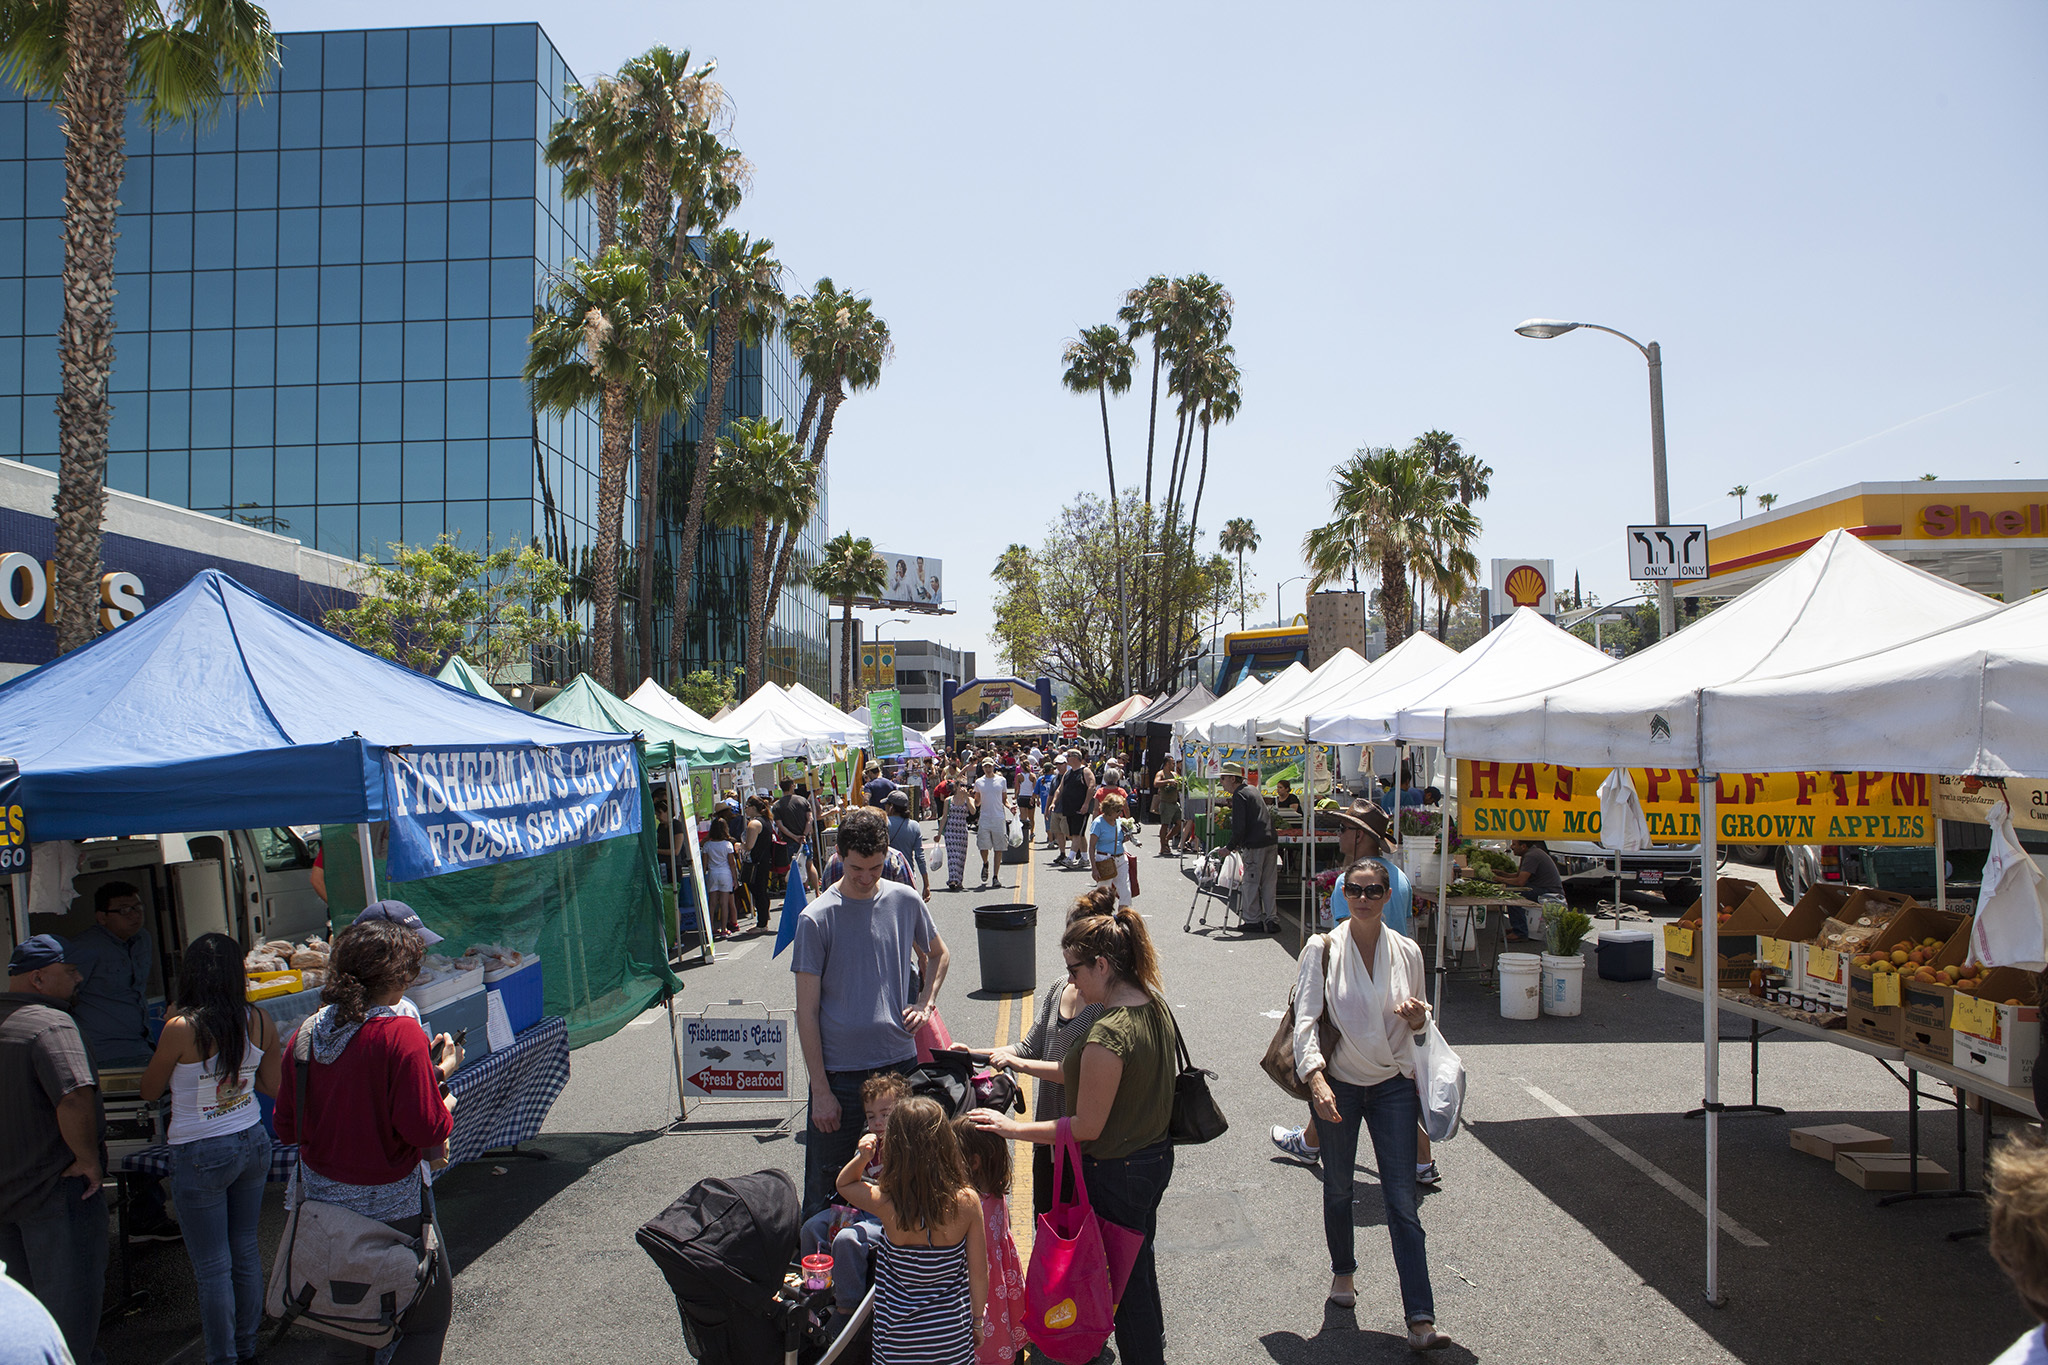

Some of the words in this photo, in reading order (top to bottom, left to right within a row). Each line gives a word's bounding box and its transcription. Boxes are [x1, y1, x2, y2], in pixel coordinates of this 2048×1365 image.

[1923, 504, 2048, 537] Shel
[1644, 566, 1668, 576] ONLY
[1681, 566, 1705, 575] ONLY
[570, 743, 637, 796] CATCH
[427, 814, 523, 867] FRESH
[526, 799, 622, 849] SEAFOOD
[1474, 808, 1550, 832] SNOW
[1562, 810, 1700, 836] MOTAIN
[1721, 813, 1816, 838] GROWN
[1828, 815, 1925, 838] APPLES
[688, 1023, 748, 1044] Fisherman's
[751, 1024, 782, 1046] Catch
[699, 1071, 733, 1088] Fresh
[736, 1072, 782, 1090] Seafood
